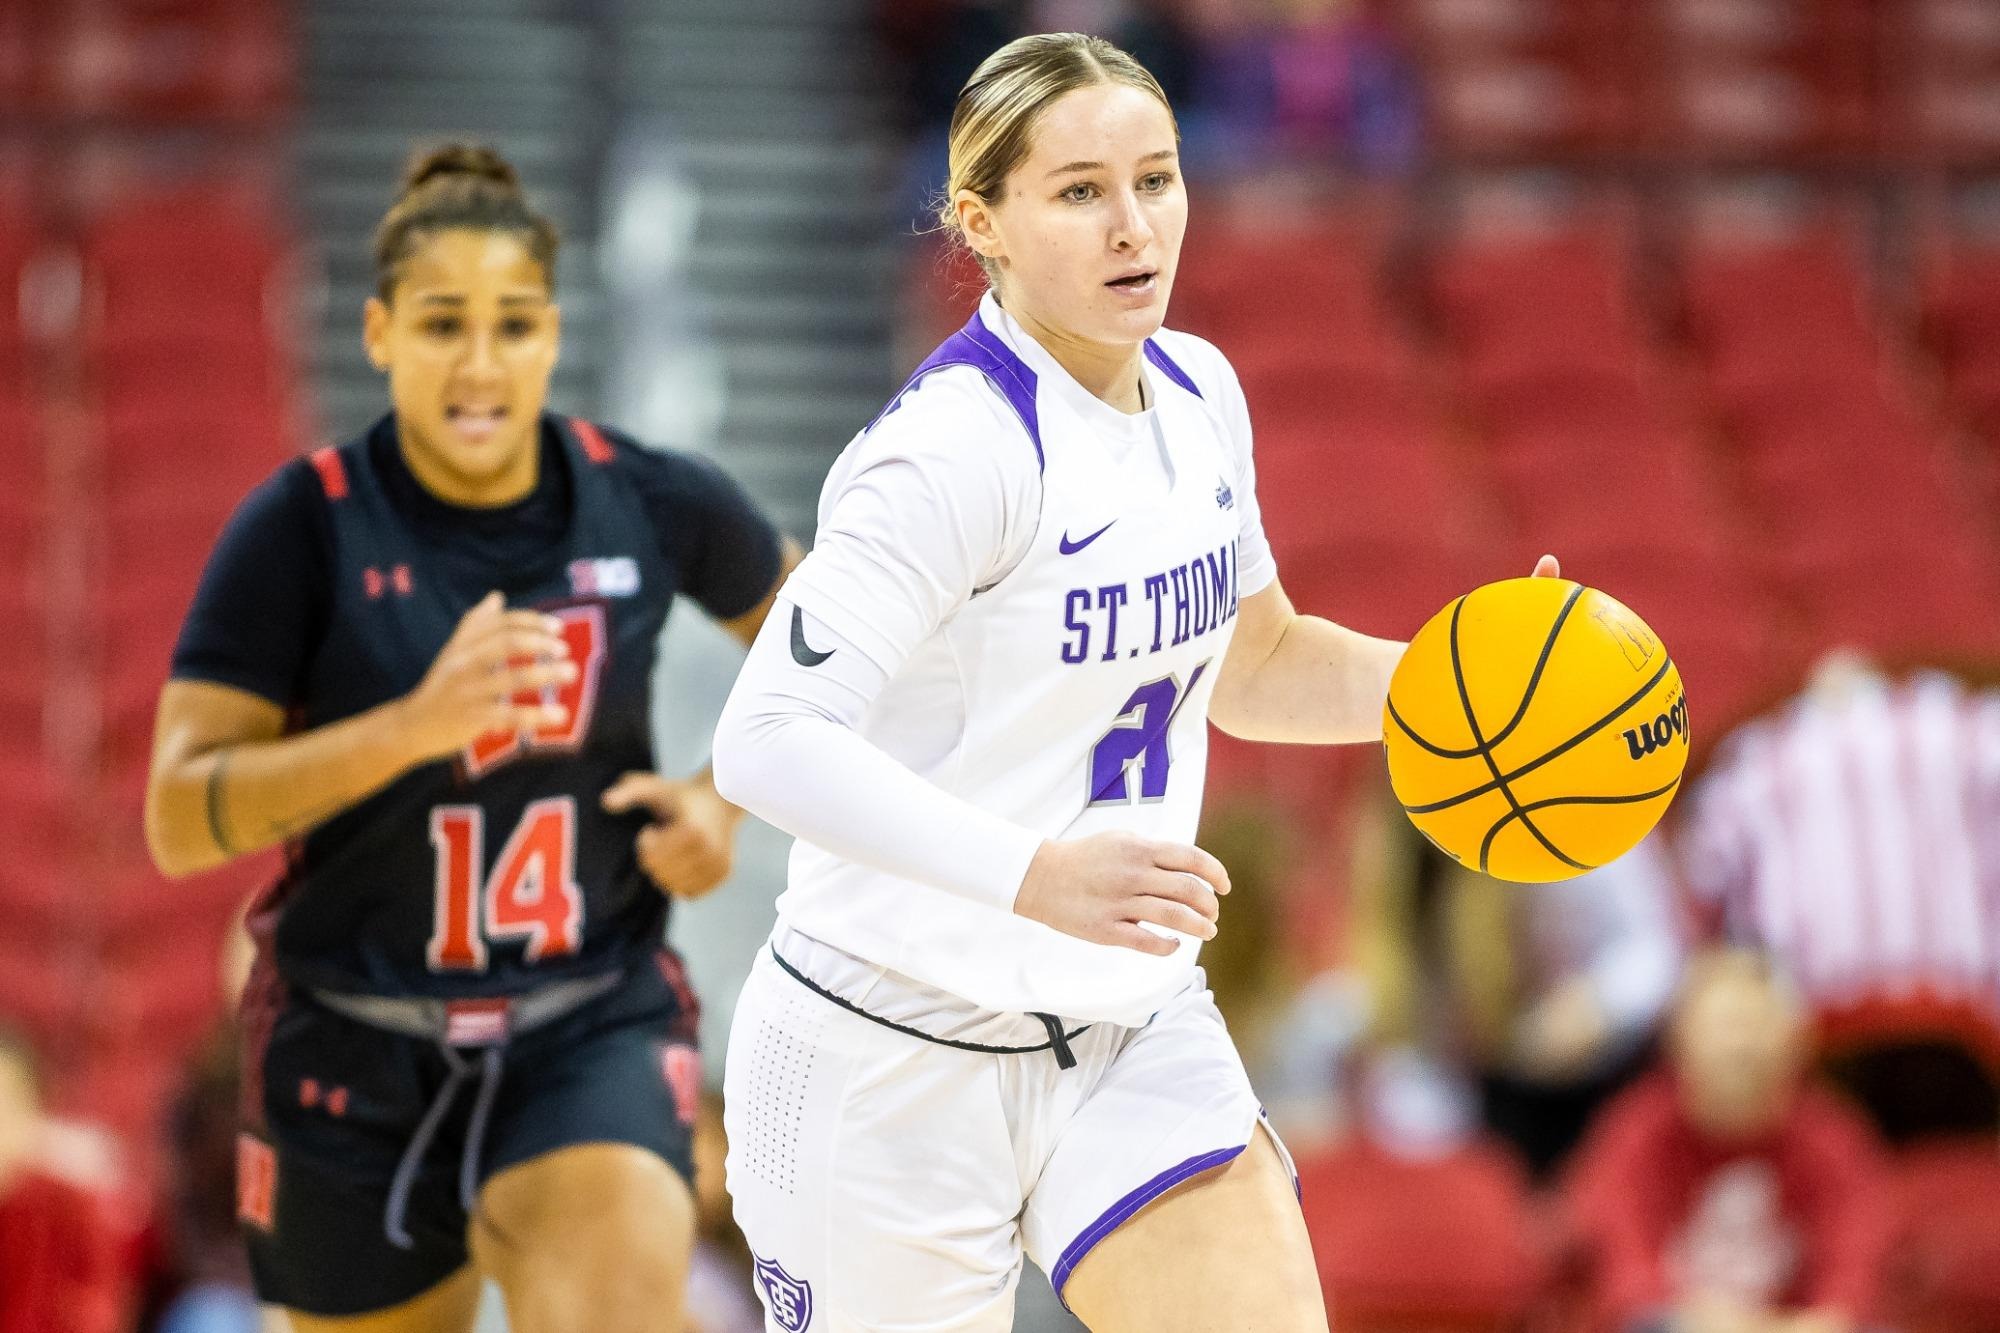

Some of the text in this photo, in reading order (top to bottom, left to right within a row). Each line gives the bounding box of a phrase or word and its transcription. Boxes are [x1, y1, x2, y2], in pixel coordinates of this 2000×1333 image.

[1061, 533, 1240, 664] ST. THOMA
[1622, 689, 1688, 760] lson
[426, 795, 584, 974] 14
